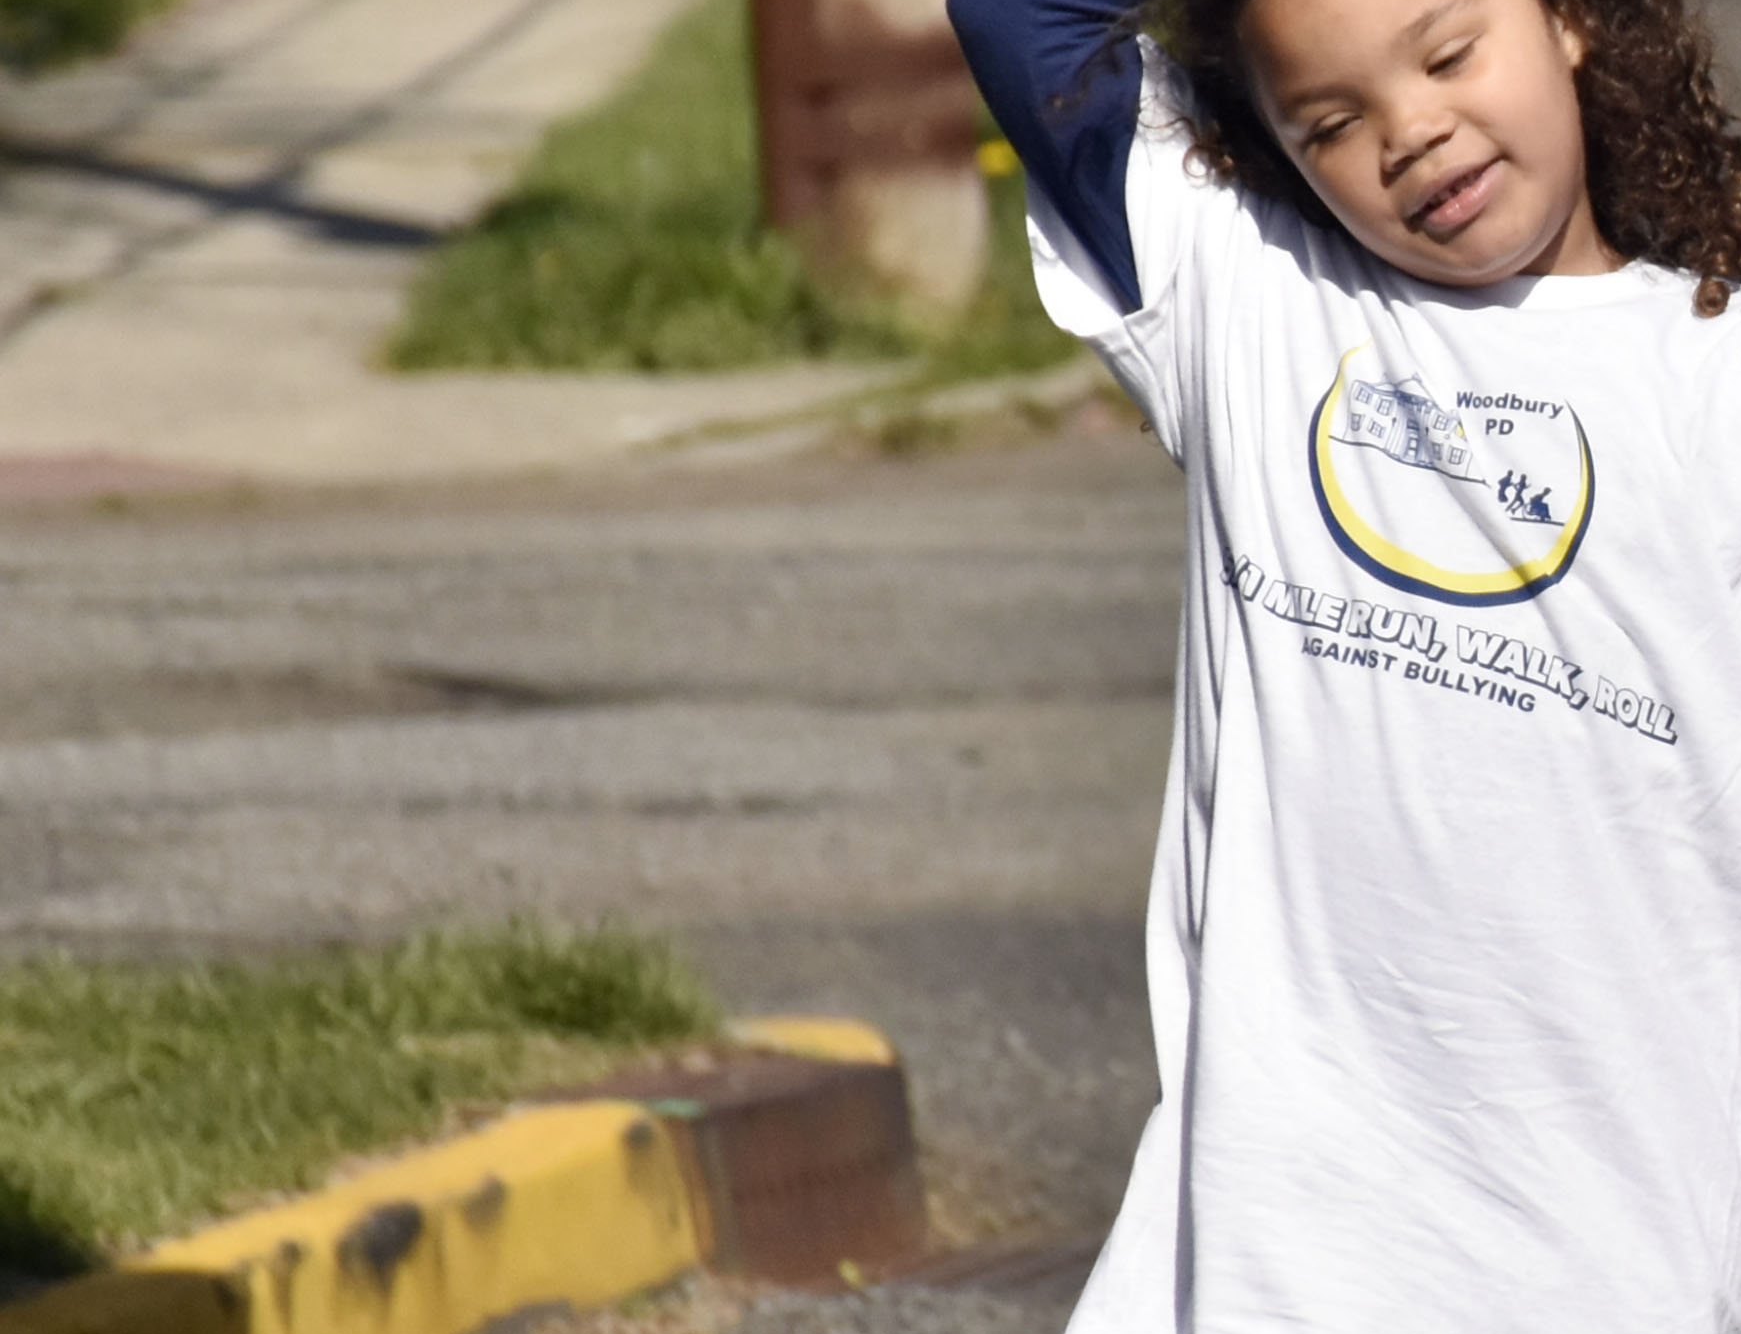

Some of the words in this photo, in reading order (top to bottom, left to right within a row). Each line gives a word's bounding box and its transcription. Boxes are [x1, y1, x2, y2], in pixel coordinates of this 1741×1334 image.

[1456, 391, 1564, 419] Woodbury
[1485, 418, 1515, 436] PD
[1262, 580, 1348, 633] MLE
[1345, 599, 1447, 662] RUN,
[1457, 625, 1589, 710] WALK,
[1593, 675, 1678, 746] ROLL
[1301, 636, 1398, 672] AGAINST
[1403, 661, 1537, 713] BULLYING
